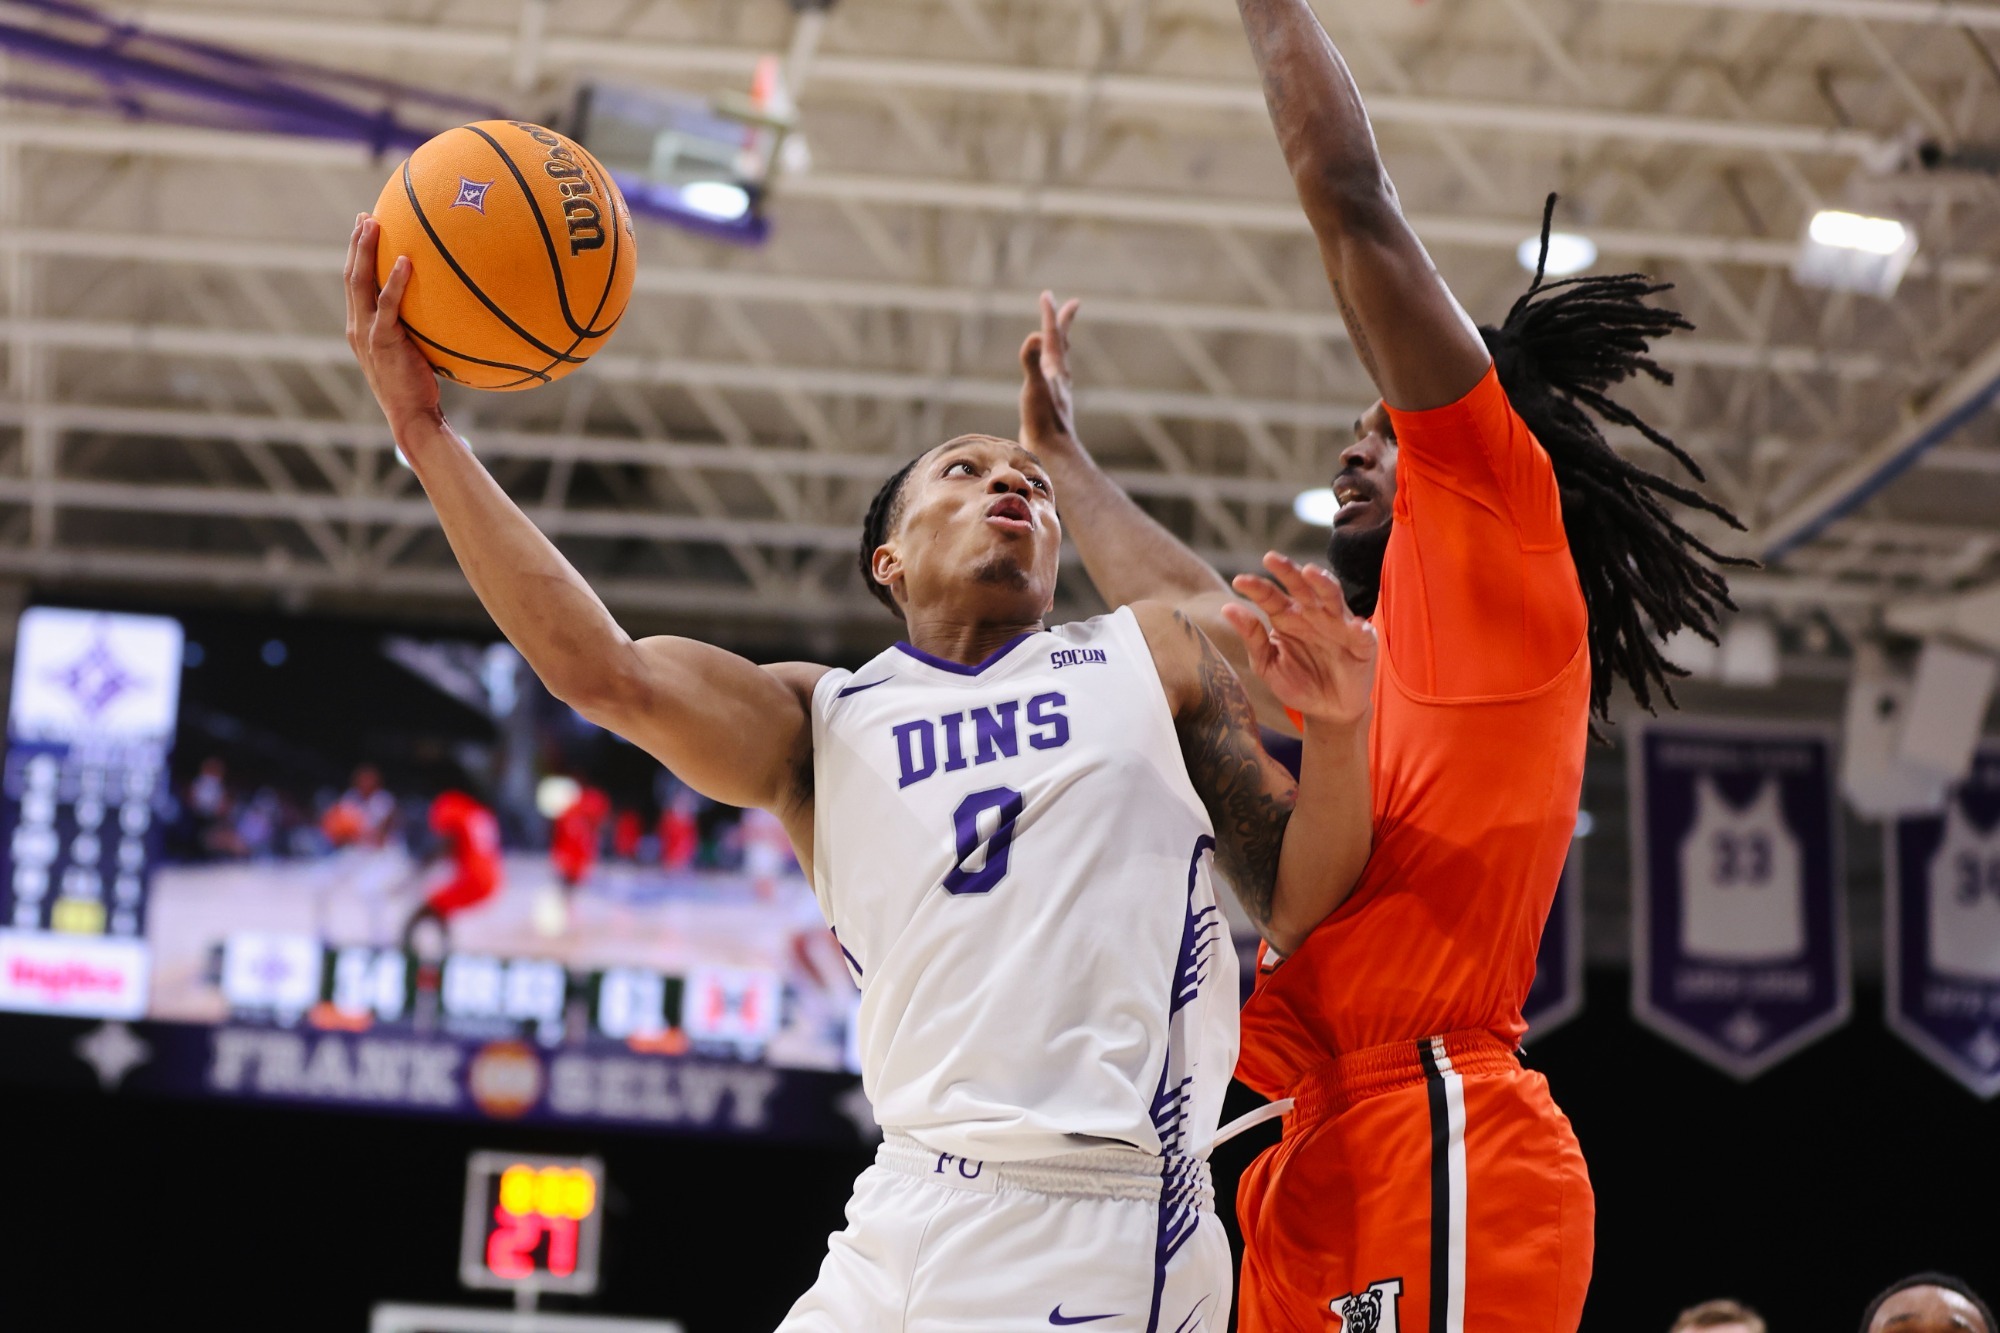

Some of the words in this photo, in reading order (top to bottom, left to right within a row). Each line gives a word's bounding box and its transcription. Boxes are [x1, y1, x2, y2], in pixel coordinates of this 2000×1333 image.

[1051, 648, 1107, 669] SOCON
[893, 691, 1070, 790] DINS
[942, 785, 1024, 895] 0
[212, 1030, 460, 1107] FRANK
